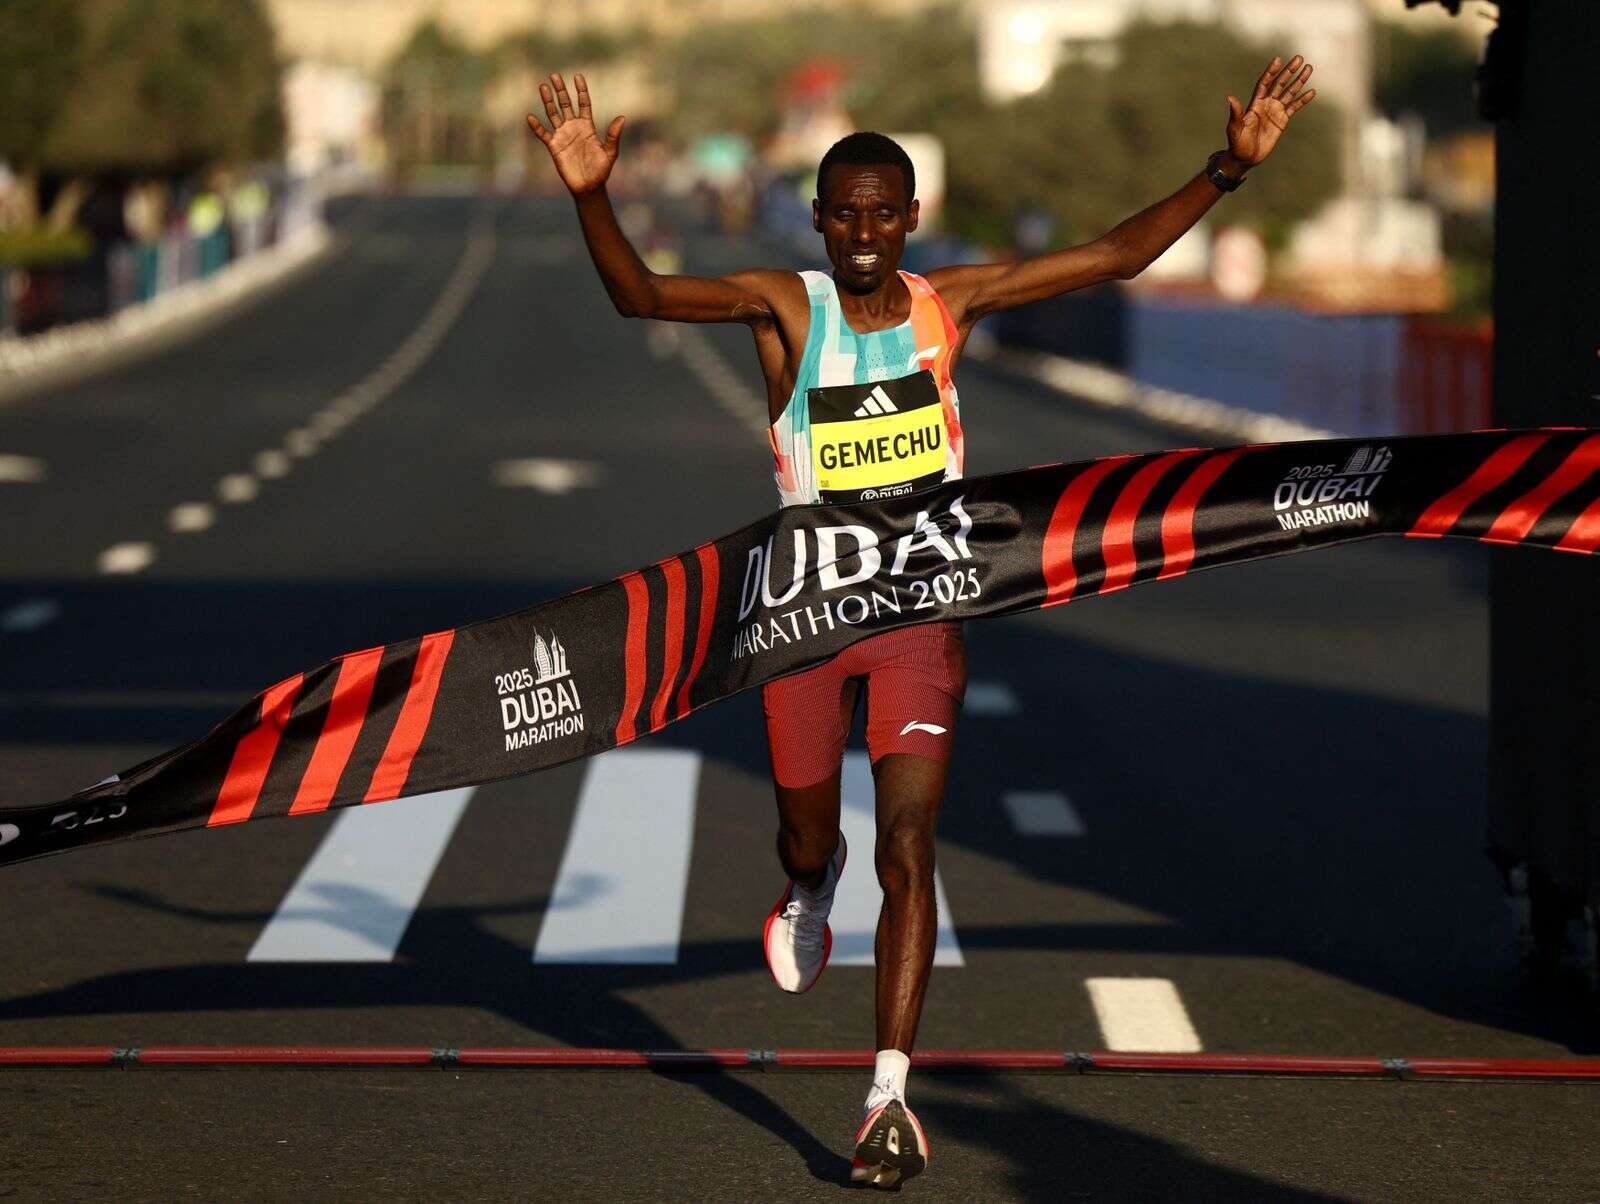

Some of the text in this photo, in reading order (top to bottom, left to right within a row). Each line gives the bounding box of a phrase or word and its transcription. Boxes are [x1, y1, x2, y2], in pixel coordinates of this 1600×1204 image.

[820, 424, 941, 470] GEMECHU
[1283, 464, 1336, 481] 2025
[1273, 475, 1383, 511] DUBAI
[1276, 501, 1369, 531] MARATHON
[738, 495, 973, 622] DUBAI
[730, 568, 982, 662] MARATHON 2025
[495, 668, 533, 695] 2025
[500, 679, 581, 730] DUBAI
[505, 713, 584, 752] MARATHON
